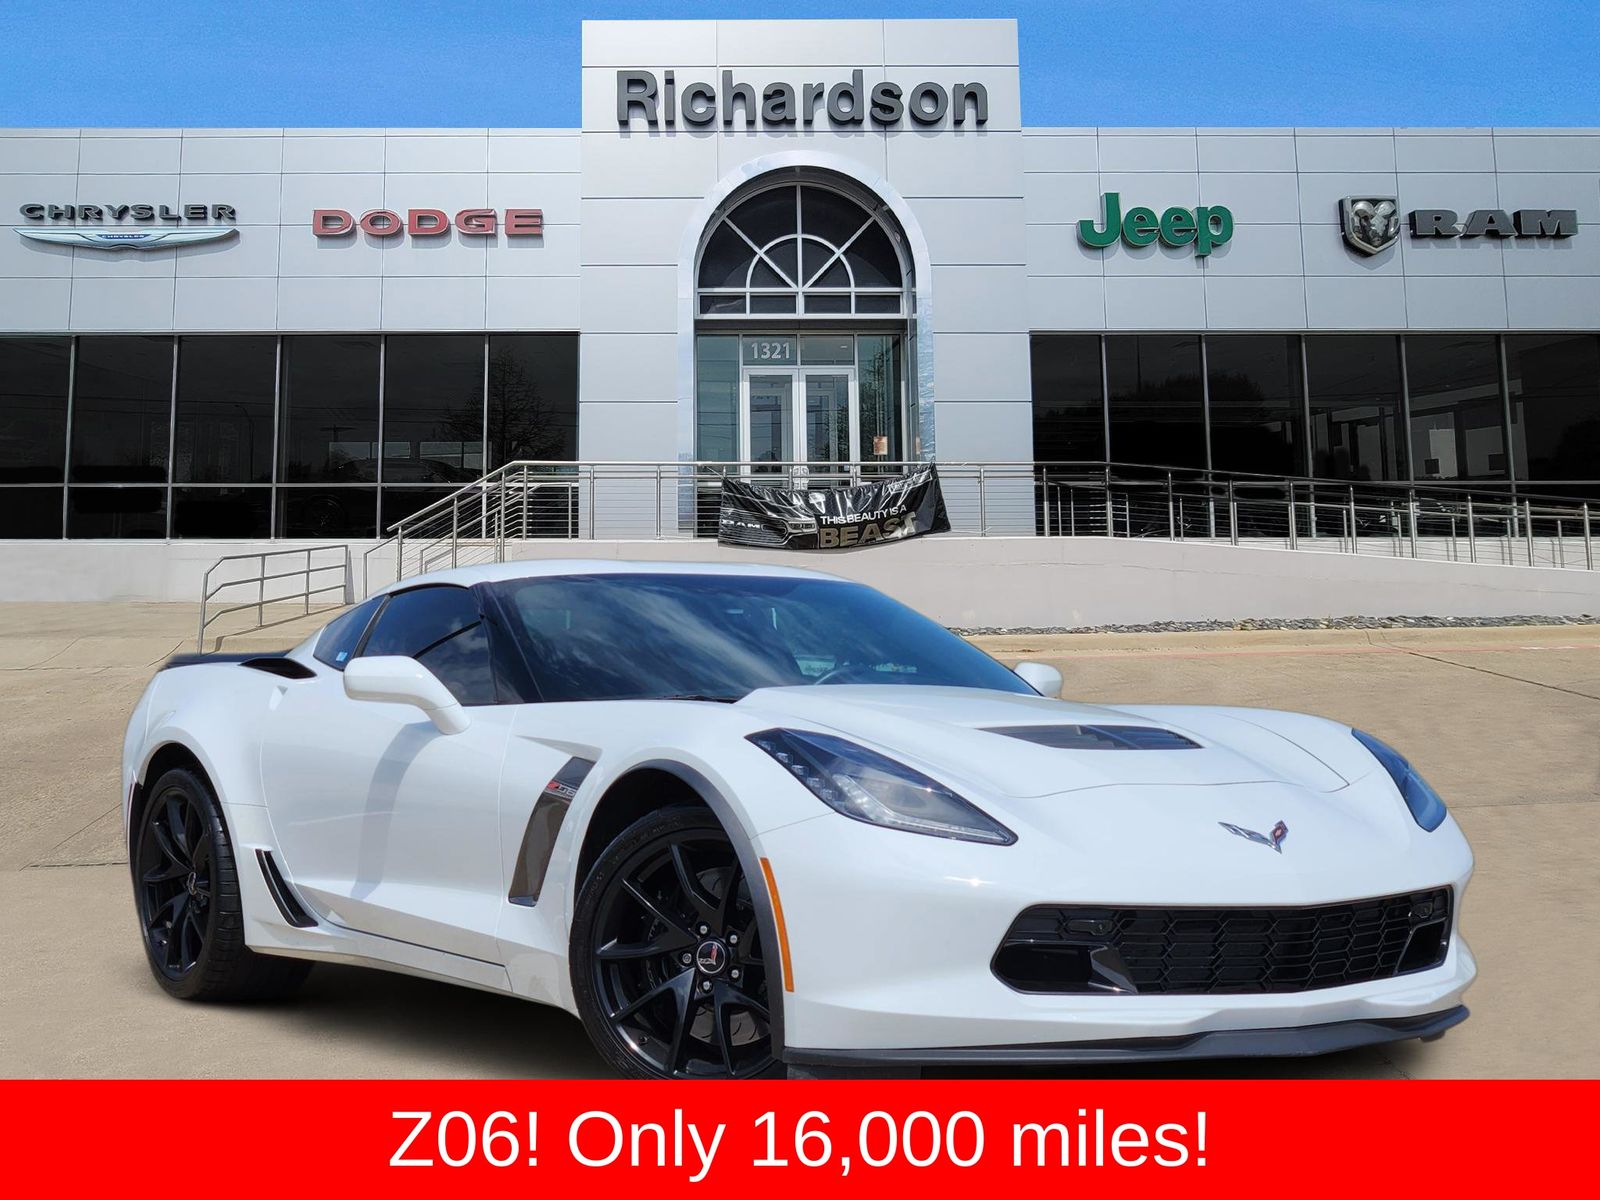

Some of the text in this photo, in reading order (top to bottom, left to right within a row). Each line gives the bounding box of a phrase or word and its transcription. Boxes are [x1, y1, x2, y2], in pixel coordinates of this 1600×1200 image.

[616, 69, 989, 126] Richardson
[19, 203, 237, 221] CHRYSLER
[312, 208, 543, 237] DODGE
[1076, 192, 1234, 257] Jeep
[1409, 209, 1577, 238] RAM
[751, 342, 790, 359] 1321
[820, 504, 907, 525] THIS BEAUTY IS A
[820, 511, 917, 548] BEAST
